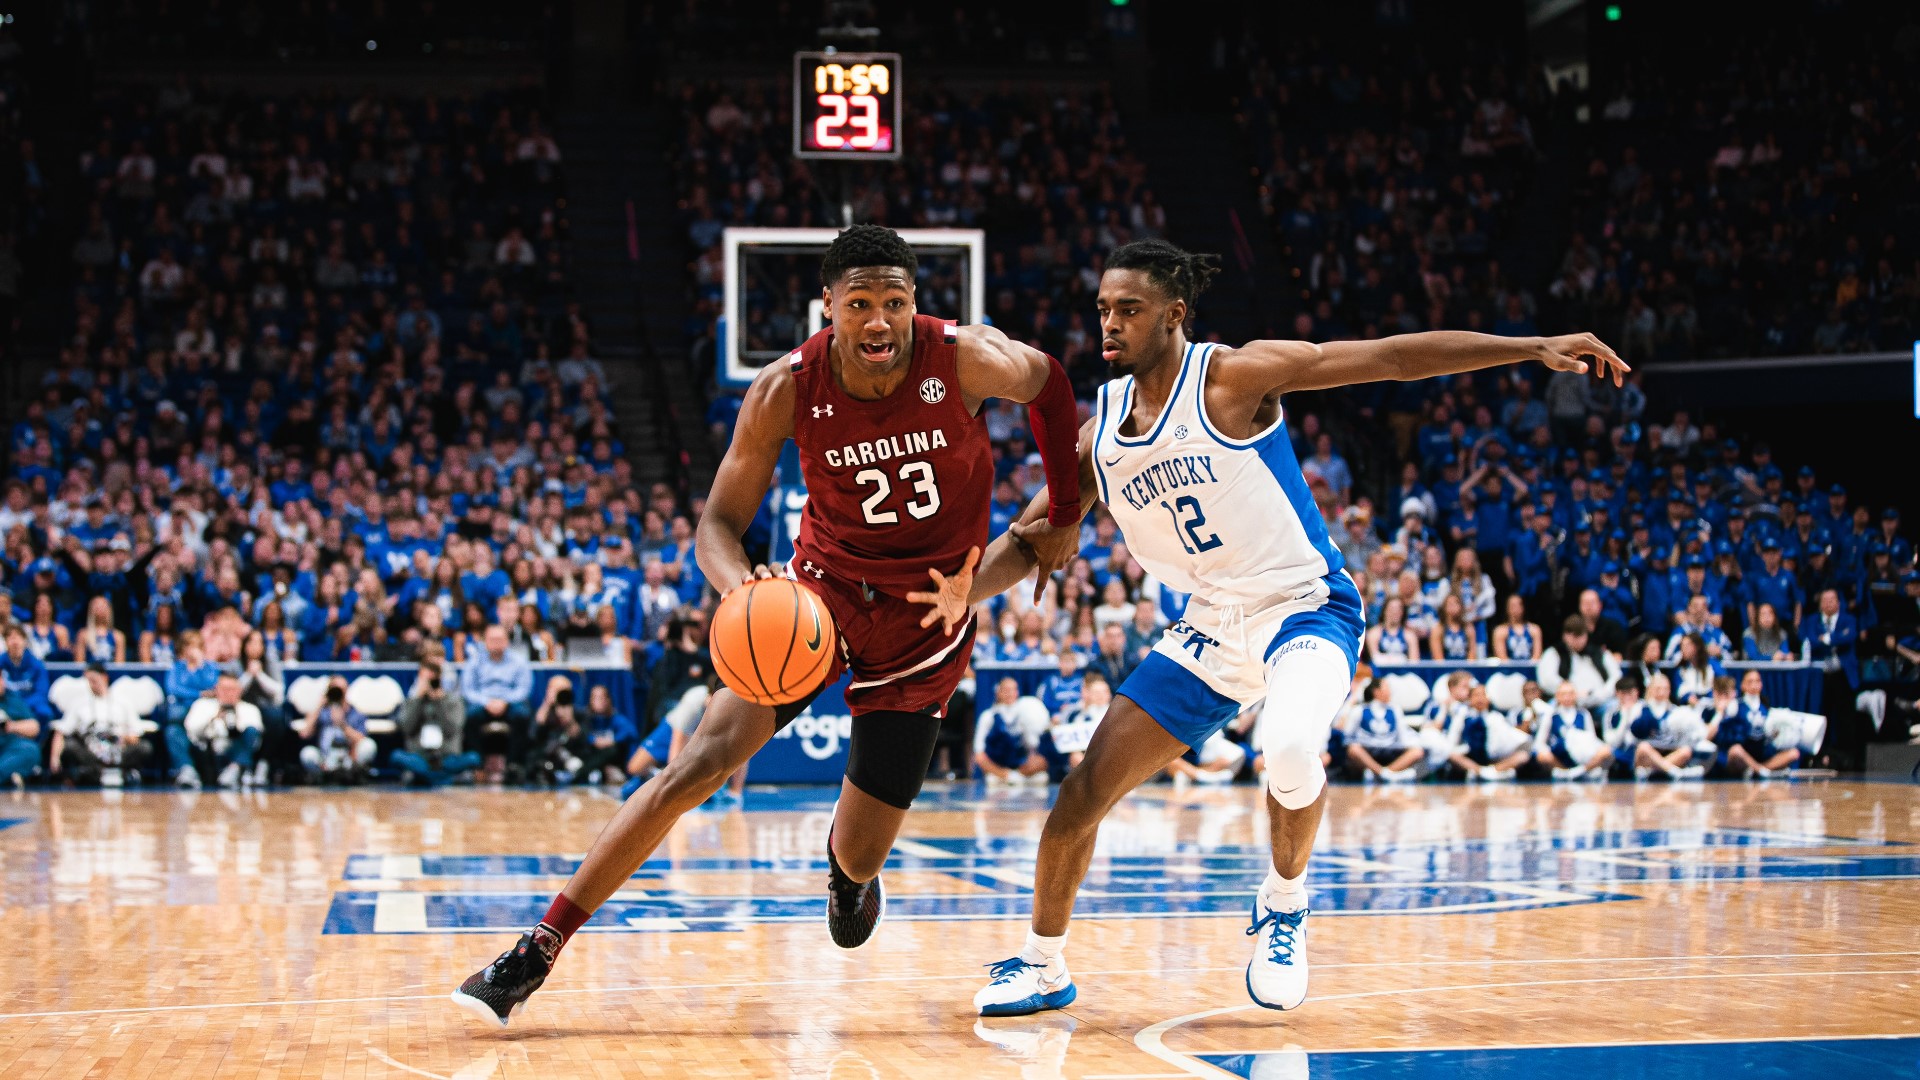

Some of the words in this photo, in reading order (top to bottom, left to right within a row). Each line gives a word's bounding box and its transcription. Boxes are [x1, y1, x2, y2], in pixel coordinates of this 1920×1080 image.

[815, 64, 889, 95] 17:59
[815, 94, 879, 148] 23
[920, 378, 945, 402] SEC
[825, 429, 948, 467] CAROLINA
[854, 460, 941, 525] 23
[1122, 455, 1218, 511] KENTUCKY
[1160, 495, 1223, 554] 12
